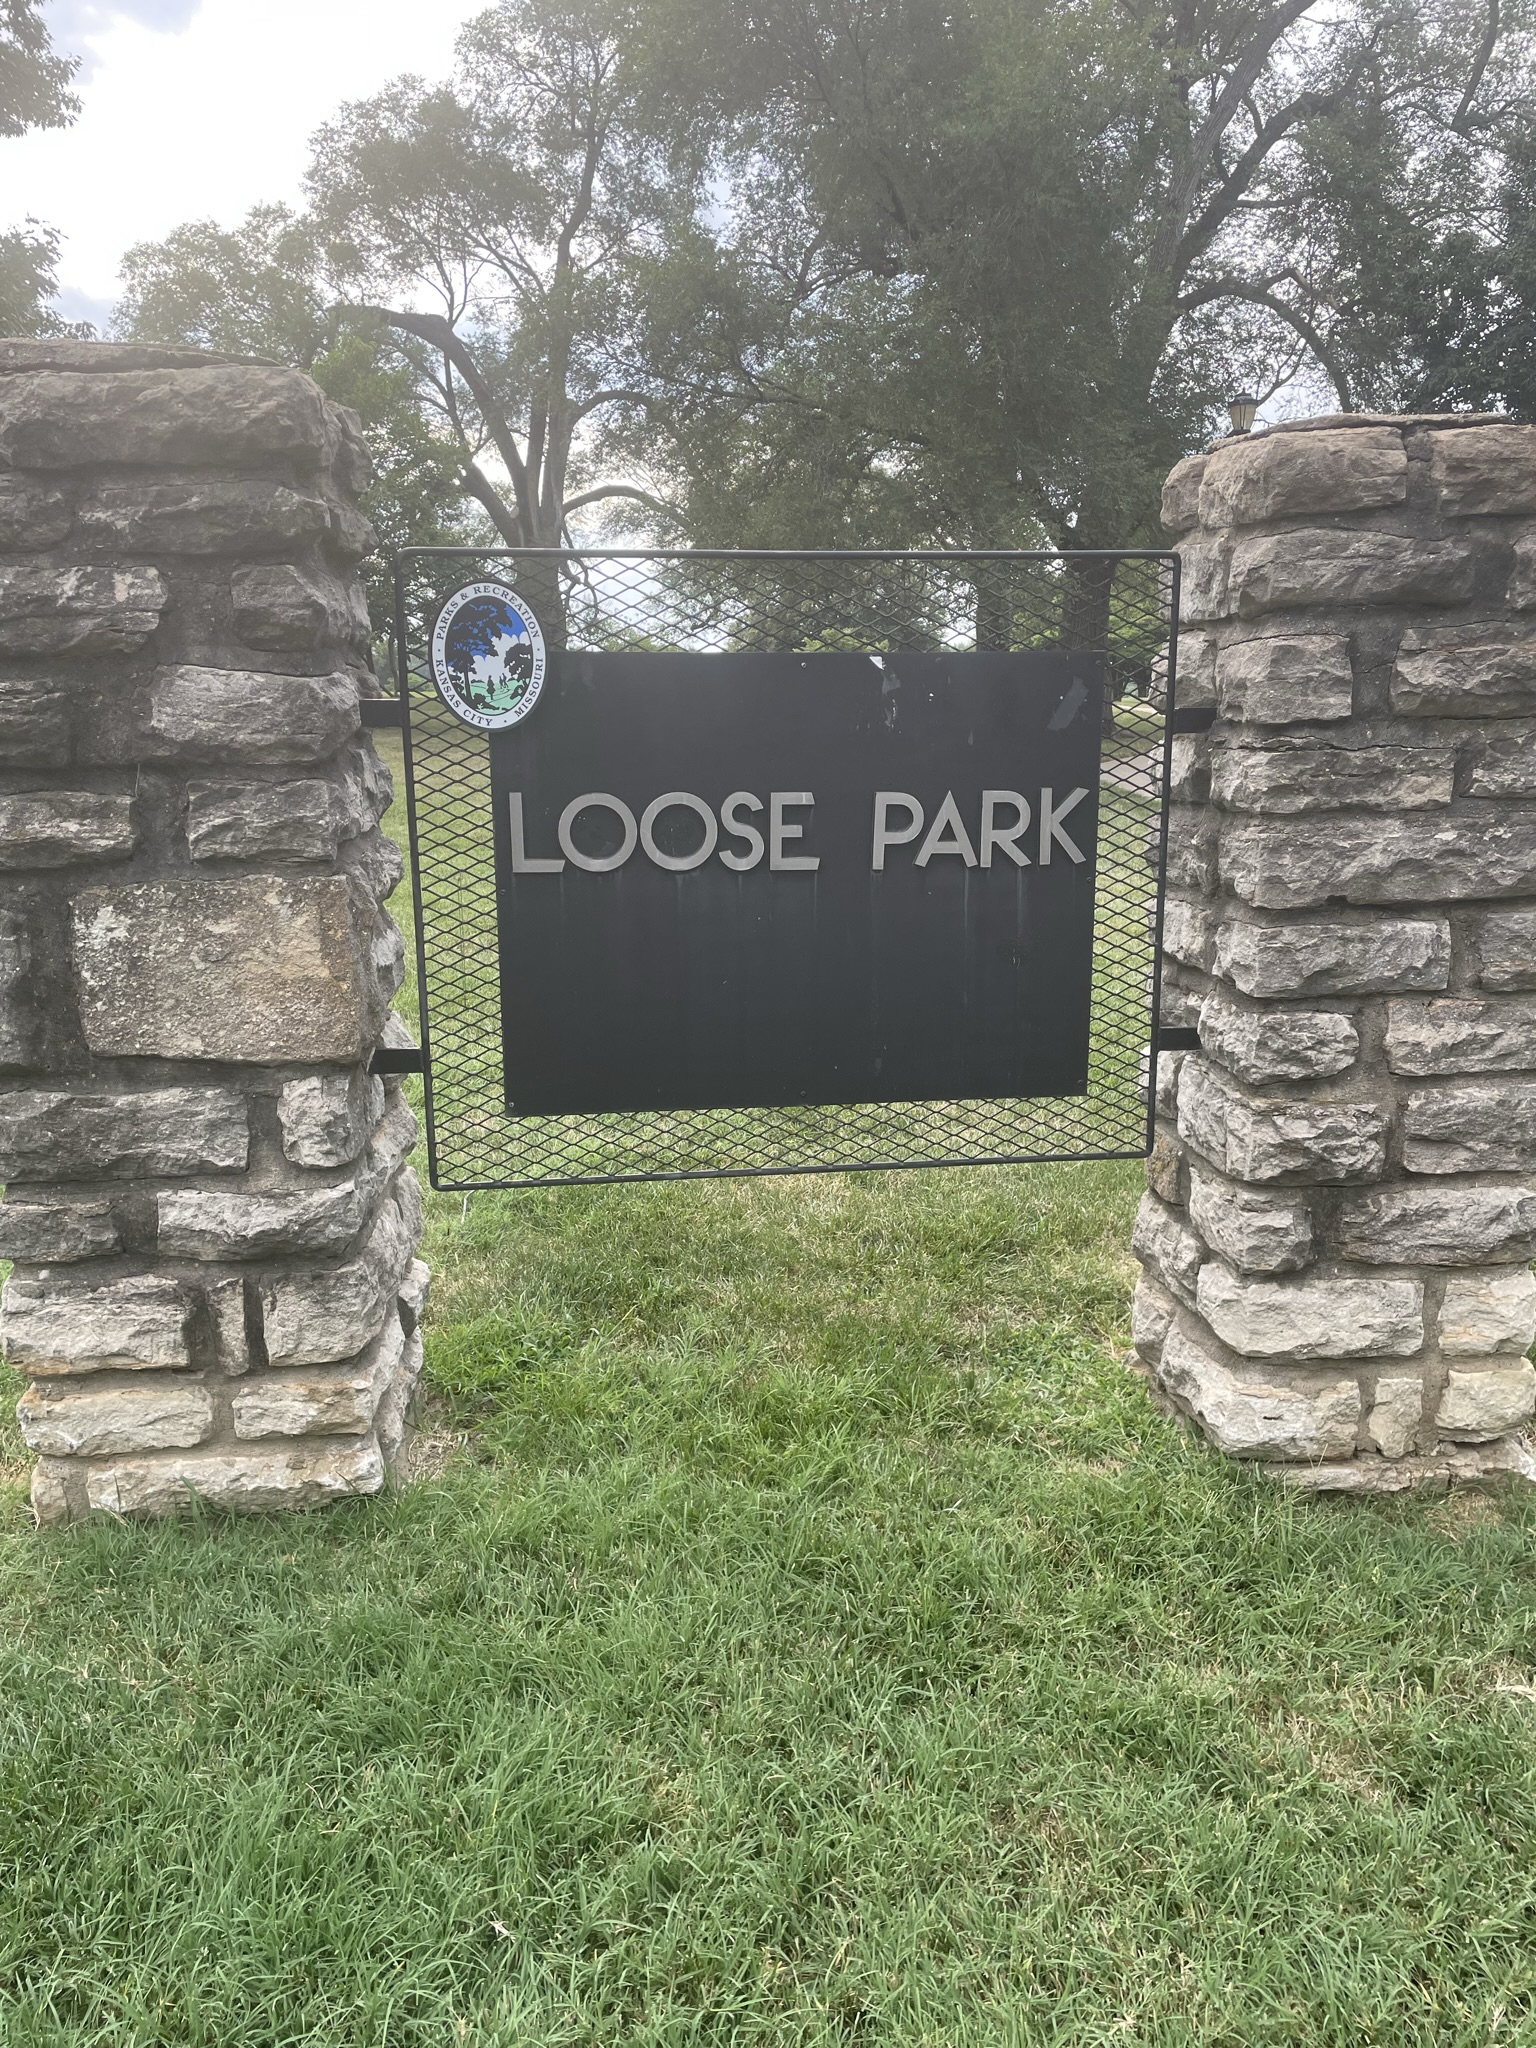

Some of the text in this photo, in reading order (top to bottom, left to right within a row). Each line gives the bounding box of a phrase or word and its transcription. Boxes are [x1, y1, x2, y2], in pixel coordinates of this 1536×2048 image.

[436, 585, 540, 641] PARKS & RECREATION
[435, 657, 544, 727] KANSAS CITY MISSOURI
[508, 786, 1090, 874] LOOSE PARK
